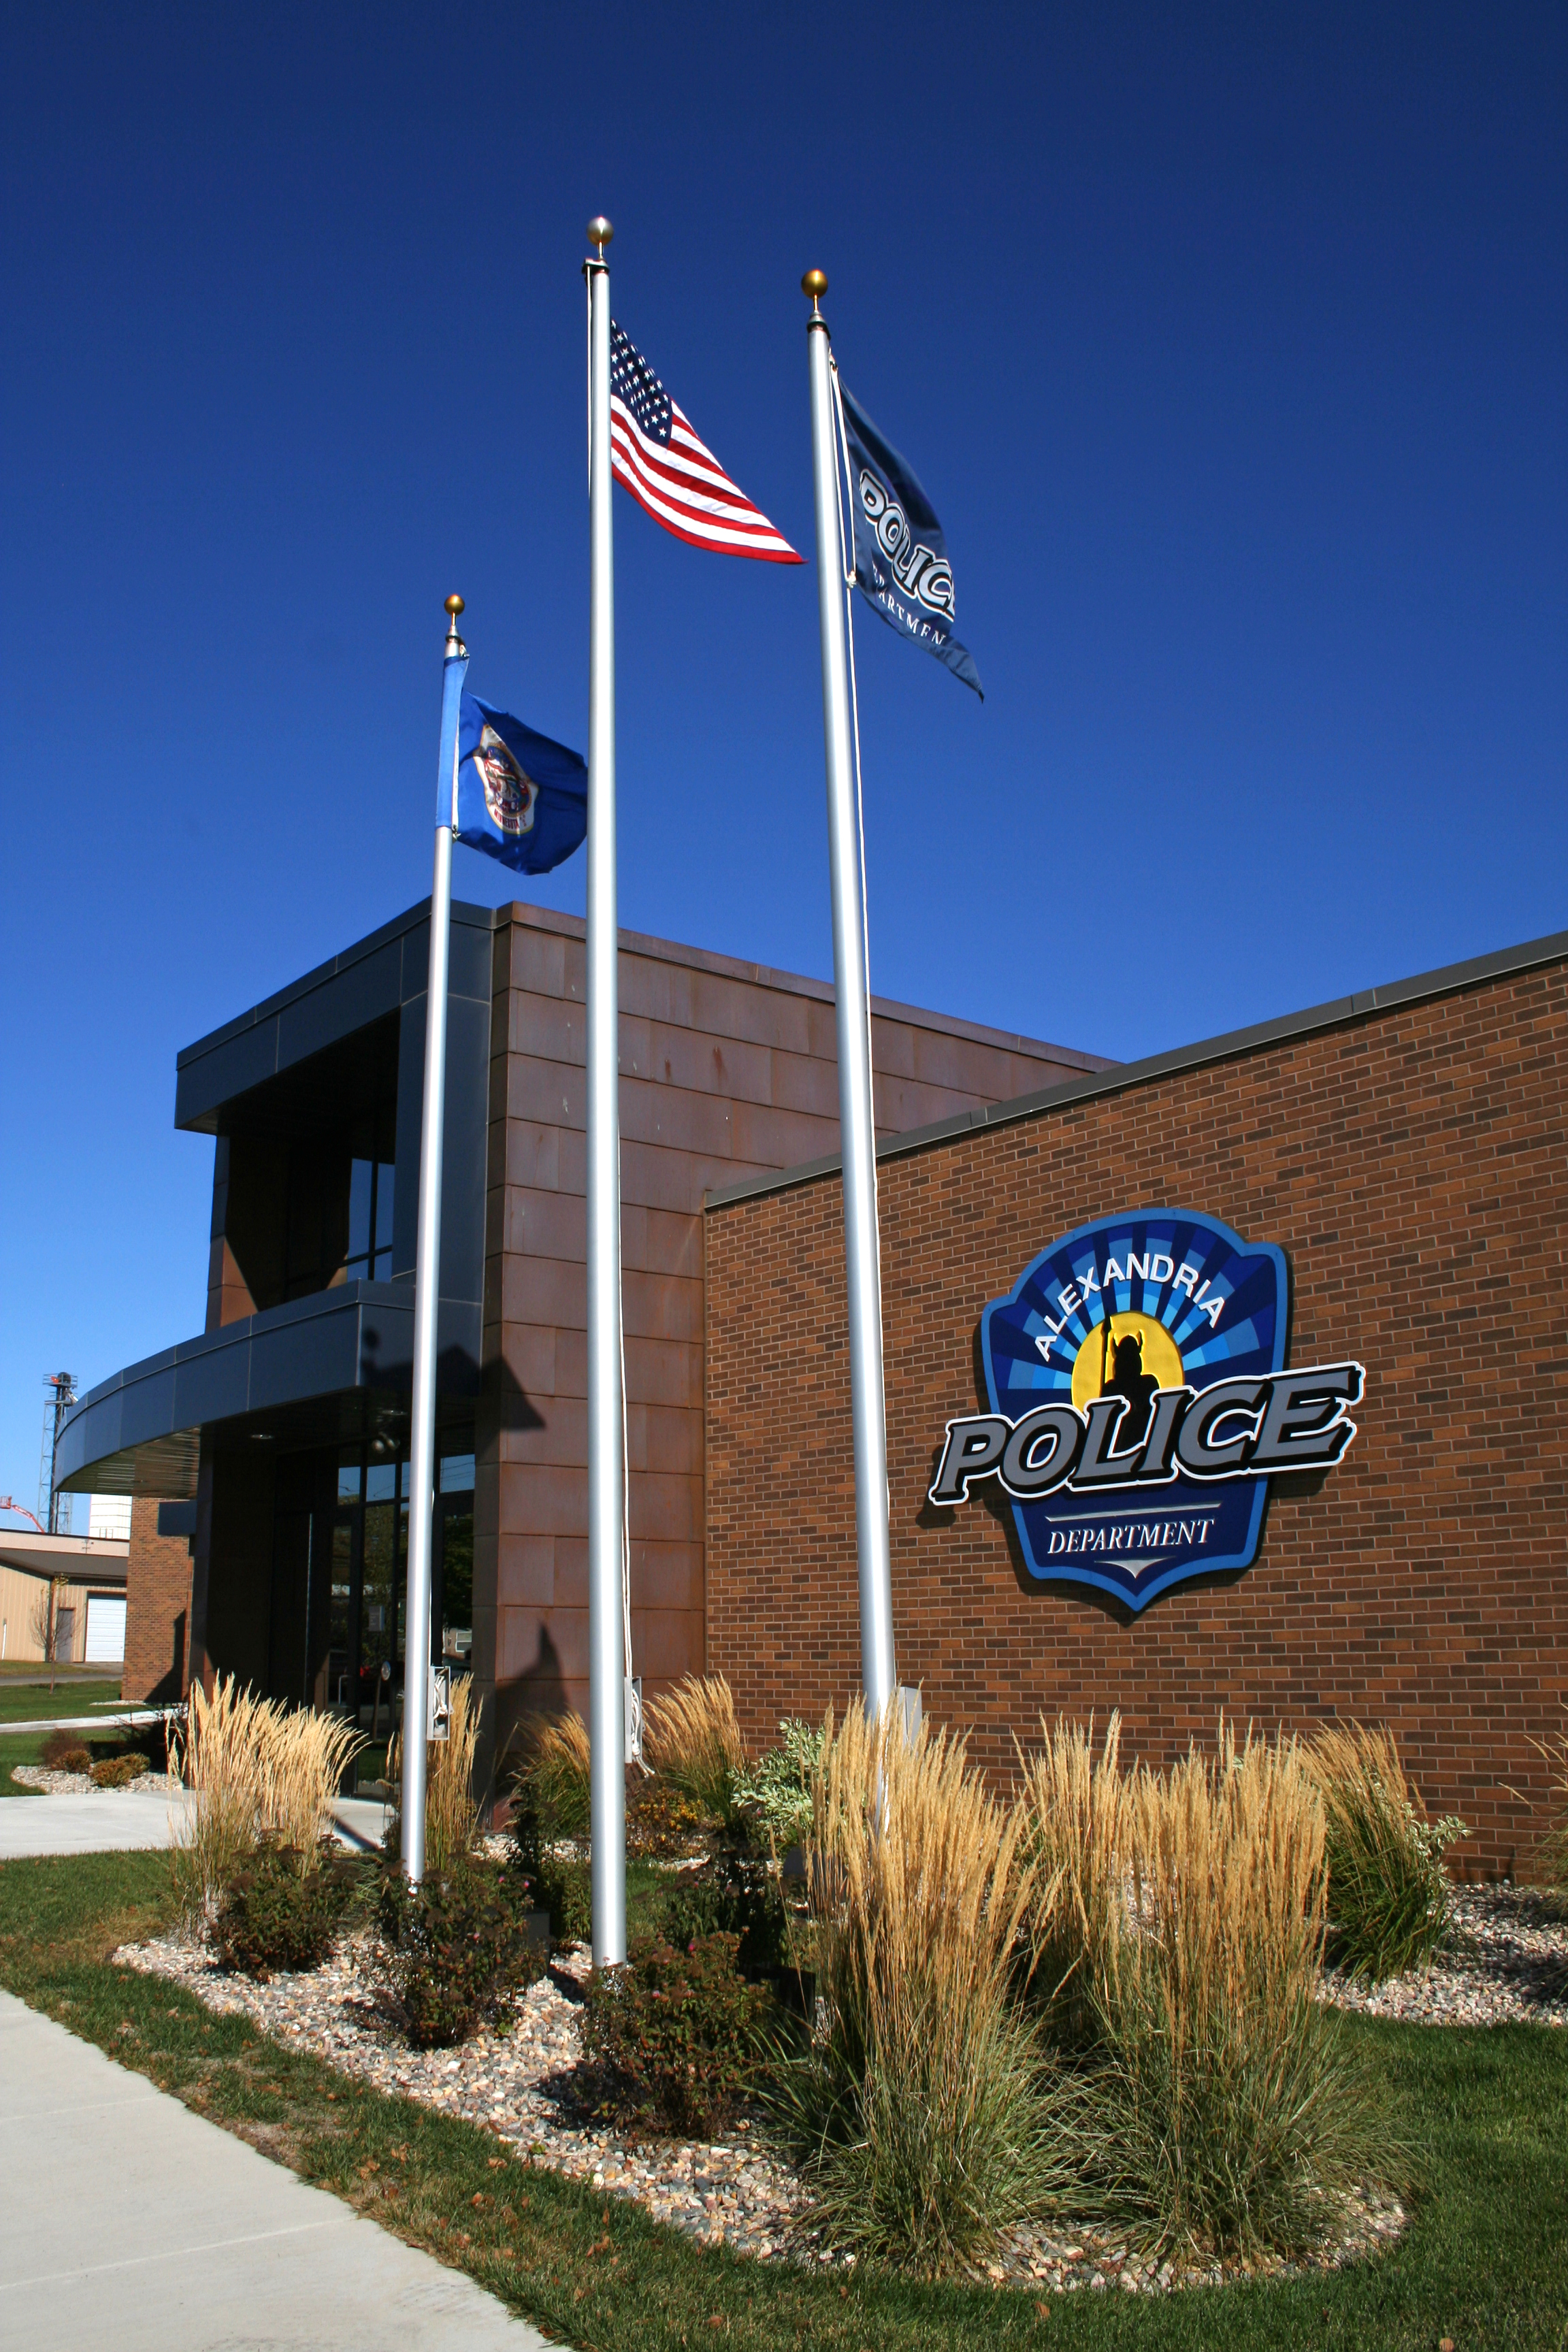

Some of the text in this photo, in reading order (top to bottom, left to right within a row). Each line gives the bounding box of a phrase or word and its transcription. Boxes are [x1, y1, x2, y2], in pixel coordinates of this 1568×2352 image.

[860, 469, 954, 623] POLIC
[1034, 1253, 1225, 1361] ALEXANDRIA
[930, 1362, 1365, 1505] POLICE
[1047, 1518, 1215, 1554] DEPARTMENT
